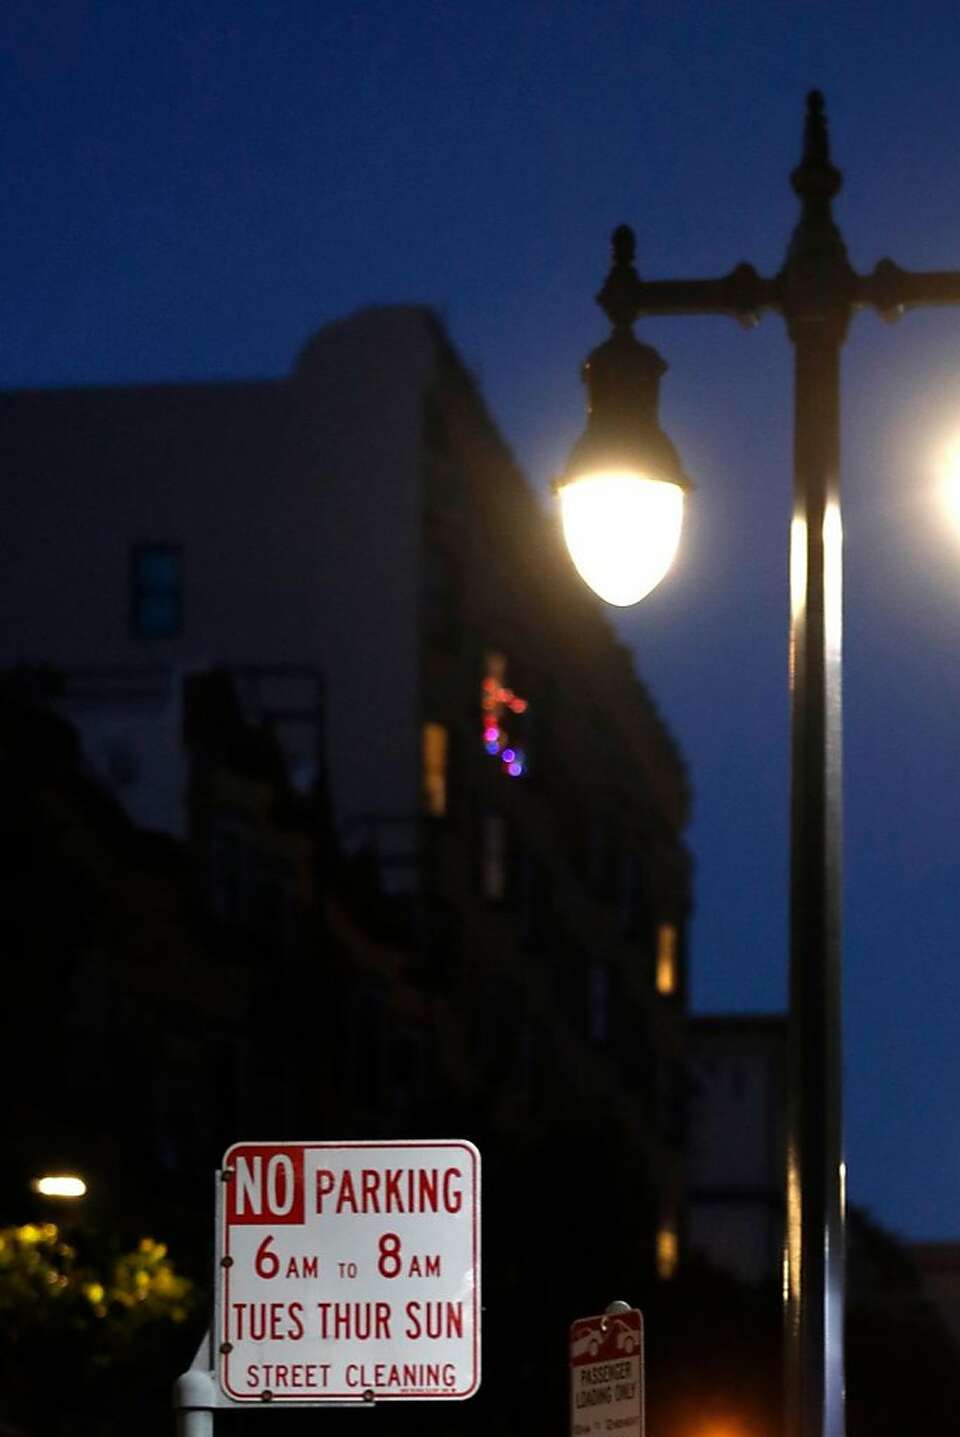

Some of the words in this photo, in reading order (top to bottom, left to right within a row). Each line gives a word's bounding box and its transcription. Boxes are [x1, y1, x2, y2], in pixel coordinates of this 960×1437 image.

[234, 1153, 296, 1217] NO
[315, 1167, 463, 1215] PARKING
[338, 1262, 358, 1279] TO
[232, 1301, 305, 1341] TUES
[317, 1301, 392, 1340] THUR
[404, 1300, 464, 1340] SUN
[246, 1363, 331, 1388] STREET
[345, 1363, 456, 1388] CLEANING
